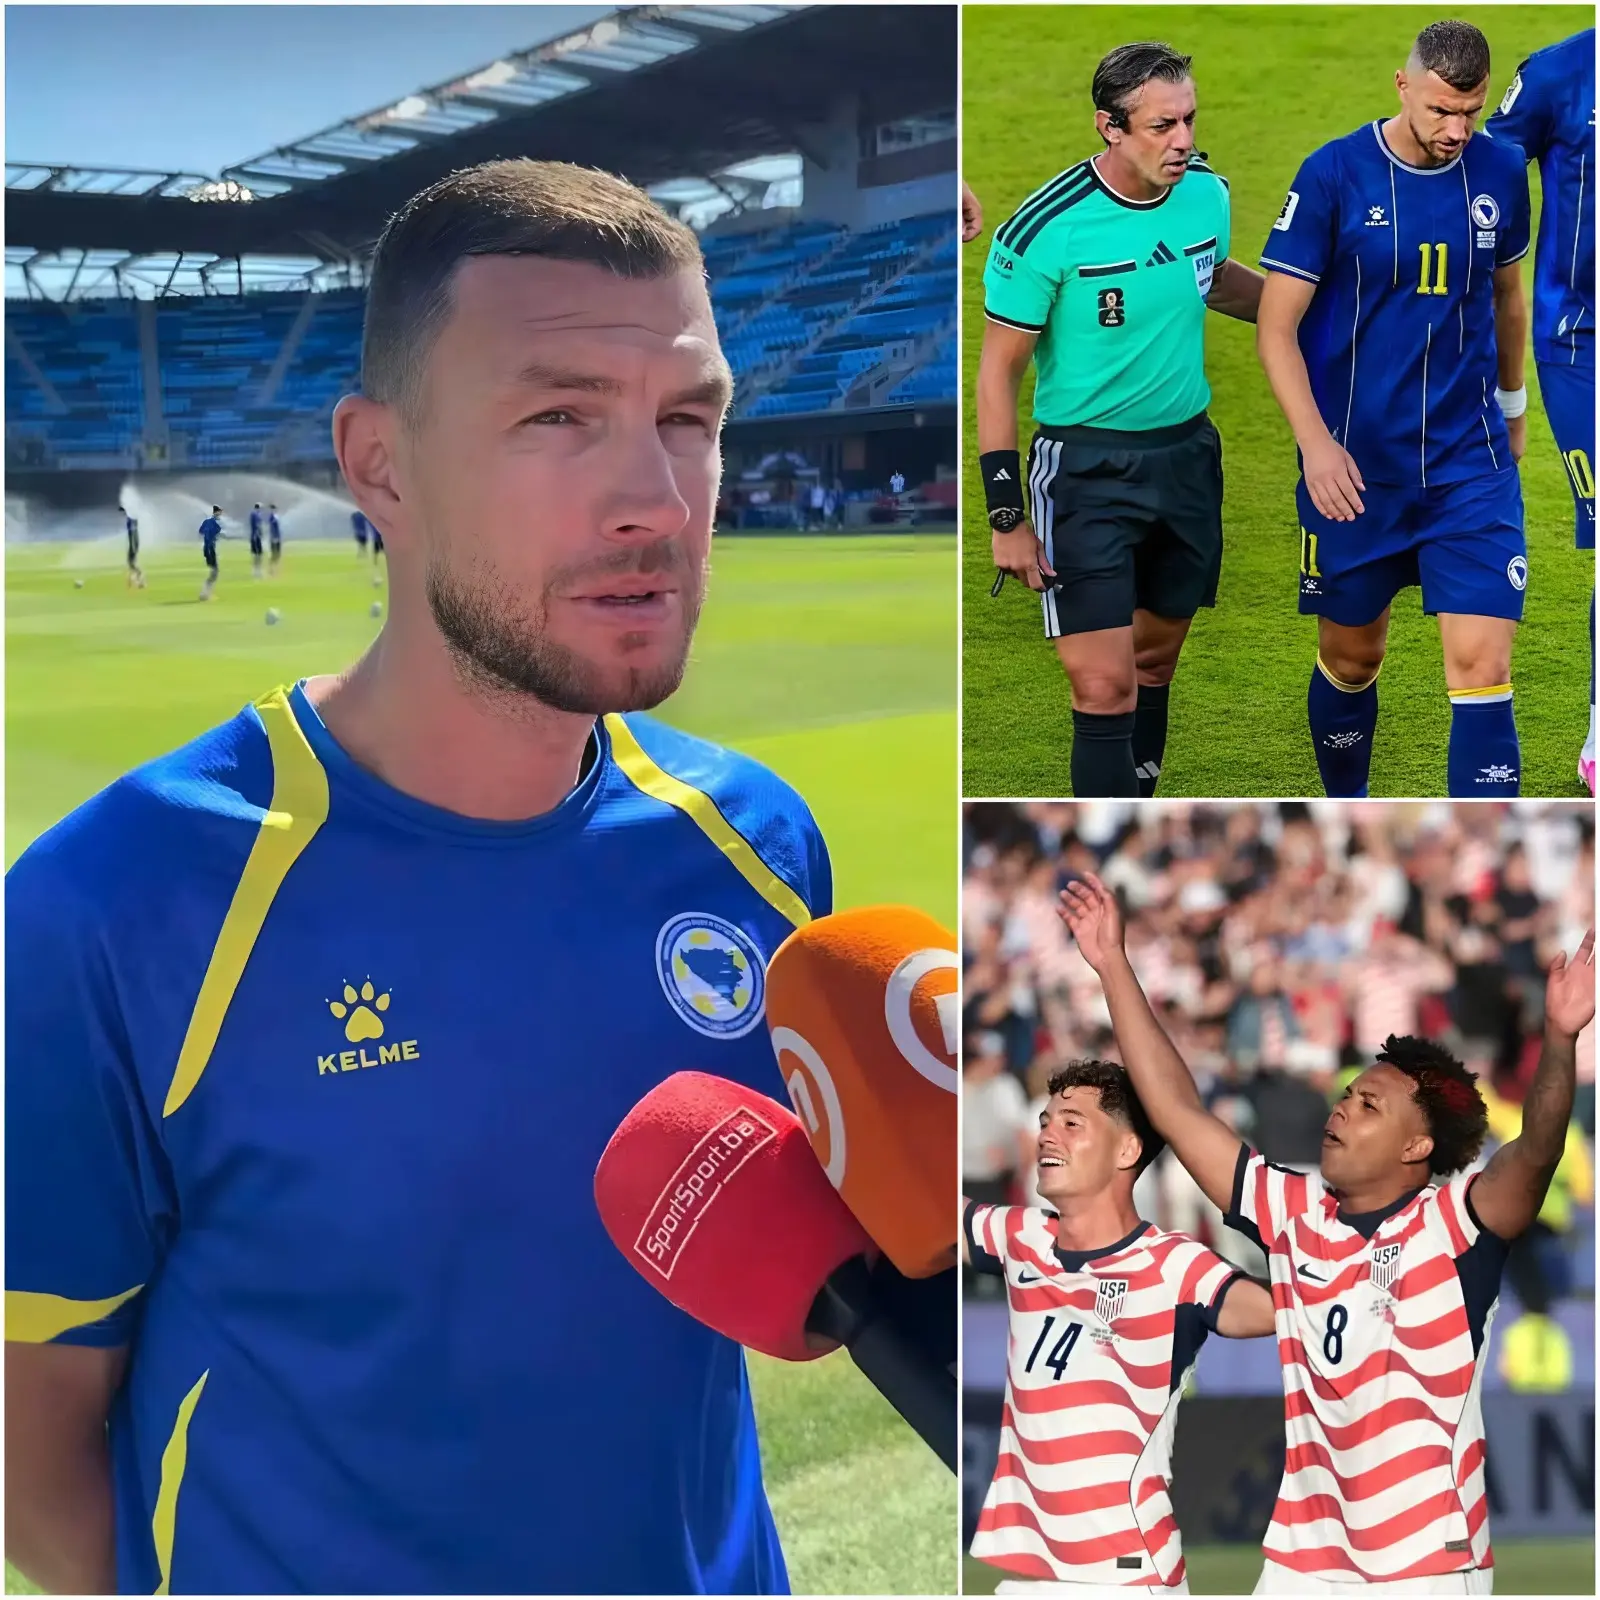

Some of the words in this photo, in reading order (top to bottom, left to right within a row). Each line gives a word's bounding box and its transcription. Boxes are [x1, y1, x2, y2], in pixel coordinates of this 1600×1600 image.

[1417, 243, 1448, 295] 11
[317, 1039, 420, 1076] KELME
[1374, 1245, 1399, 1265] USA
[1099, 1281, 1127, 1299] USA
[1024, 1315, 1084, 1381] 14
[1323, 1304, 1348, 1365] 8
